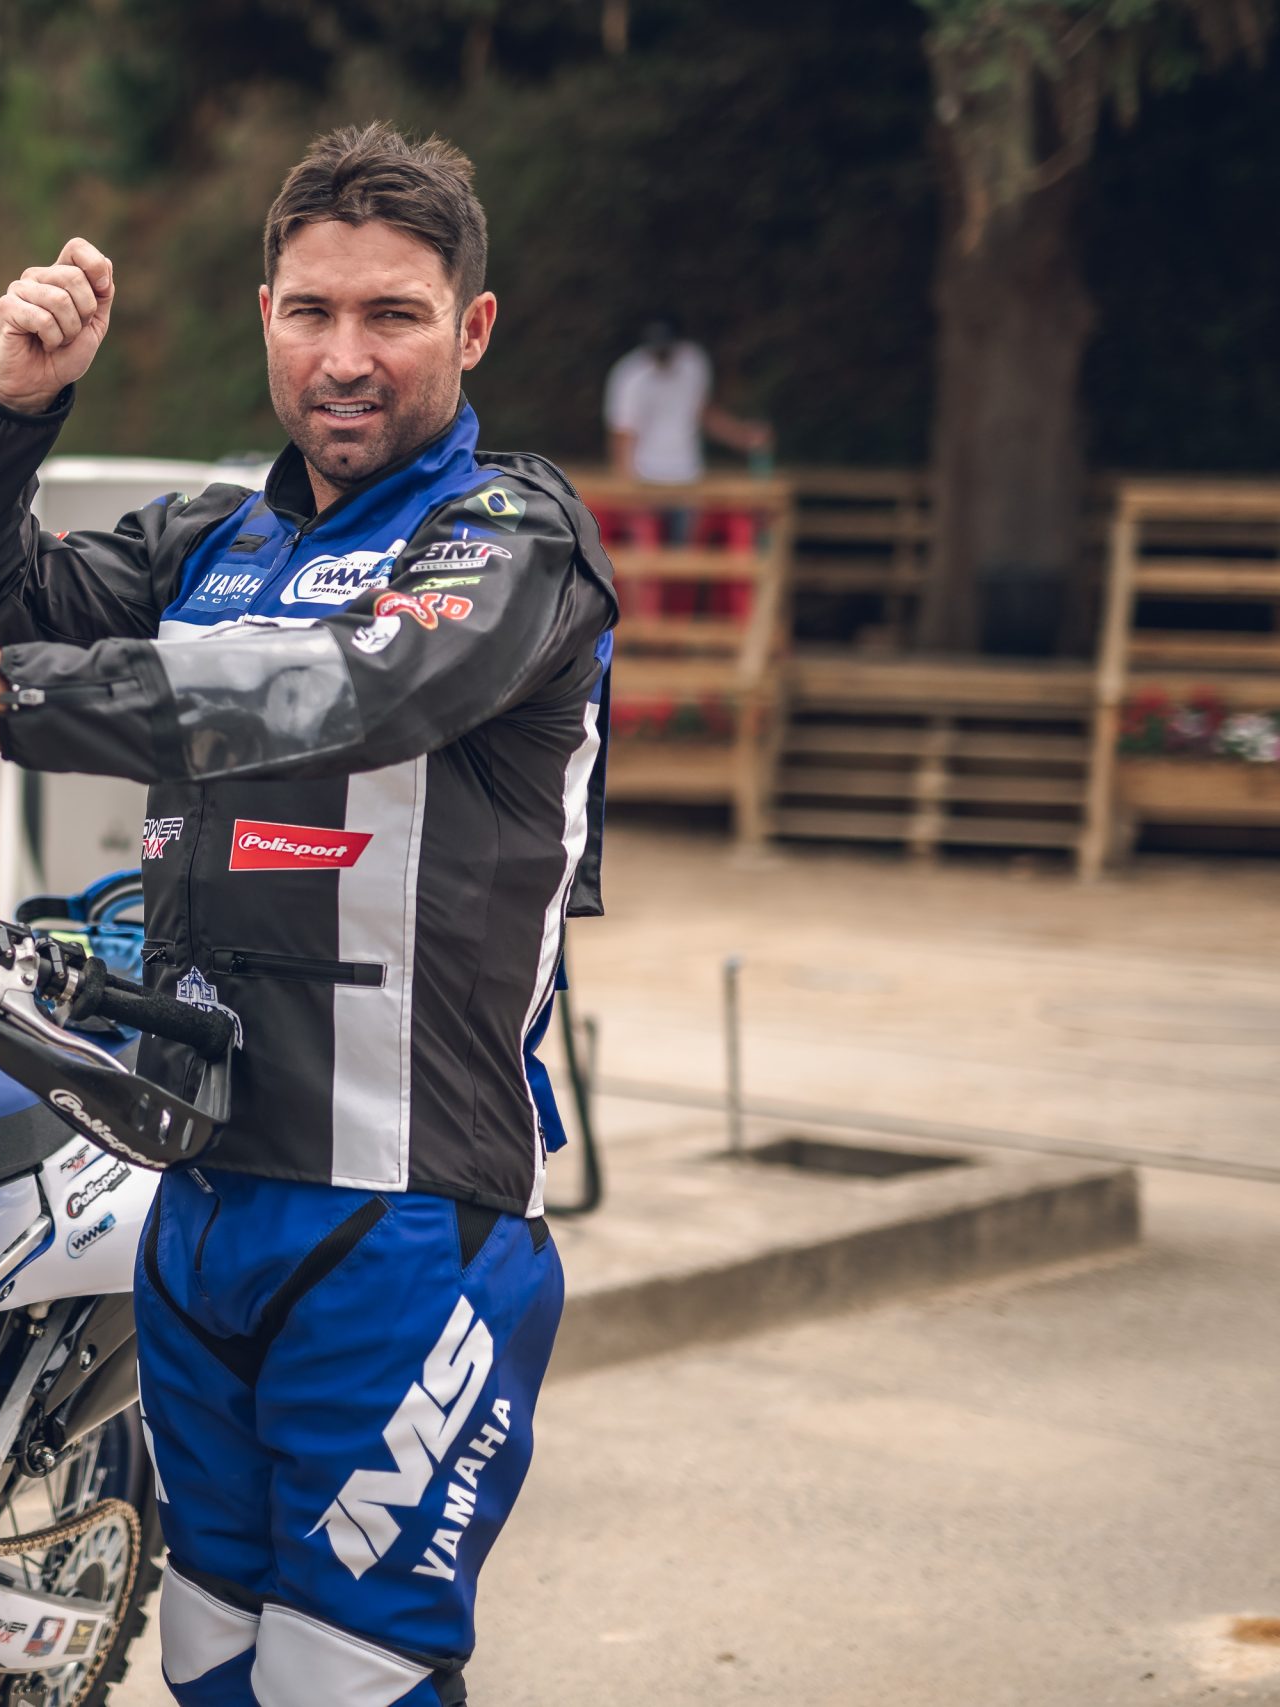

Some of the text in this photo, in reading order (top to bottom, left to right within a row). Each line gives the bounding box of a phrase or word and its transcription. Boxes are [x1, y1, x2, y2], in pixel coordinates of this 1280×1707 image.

[238, 832, 348, 858] Polisport
[50, 1088, 170, 1169] Polisport
[303, 1293, 494, 1581] IMS
[411, 1397, 511, 1582] YAMAHA
